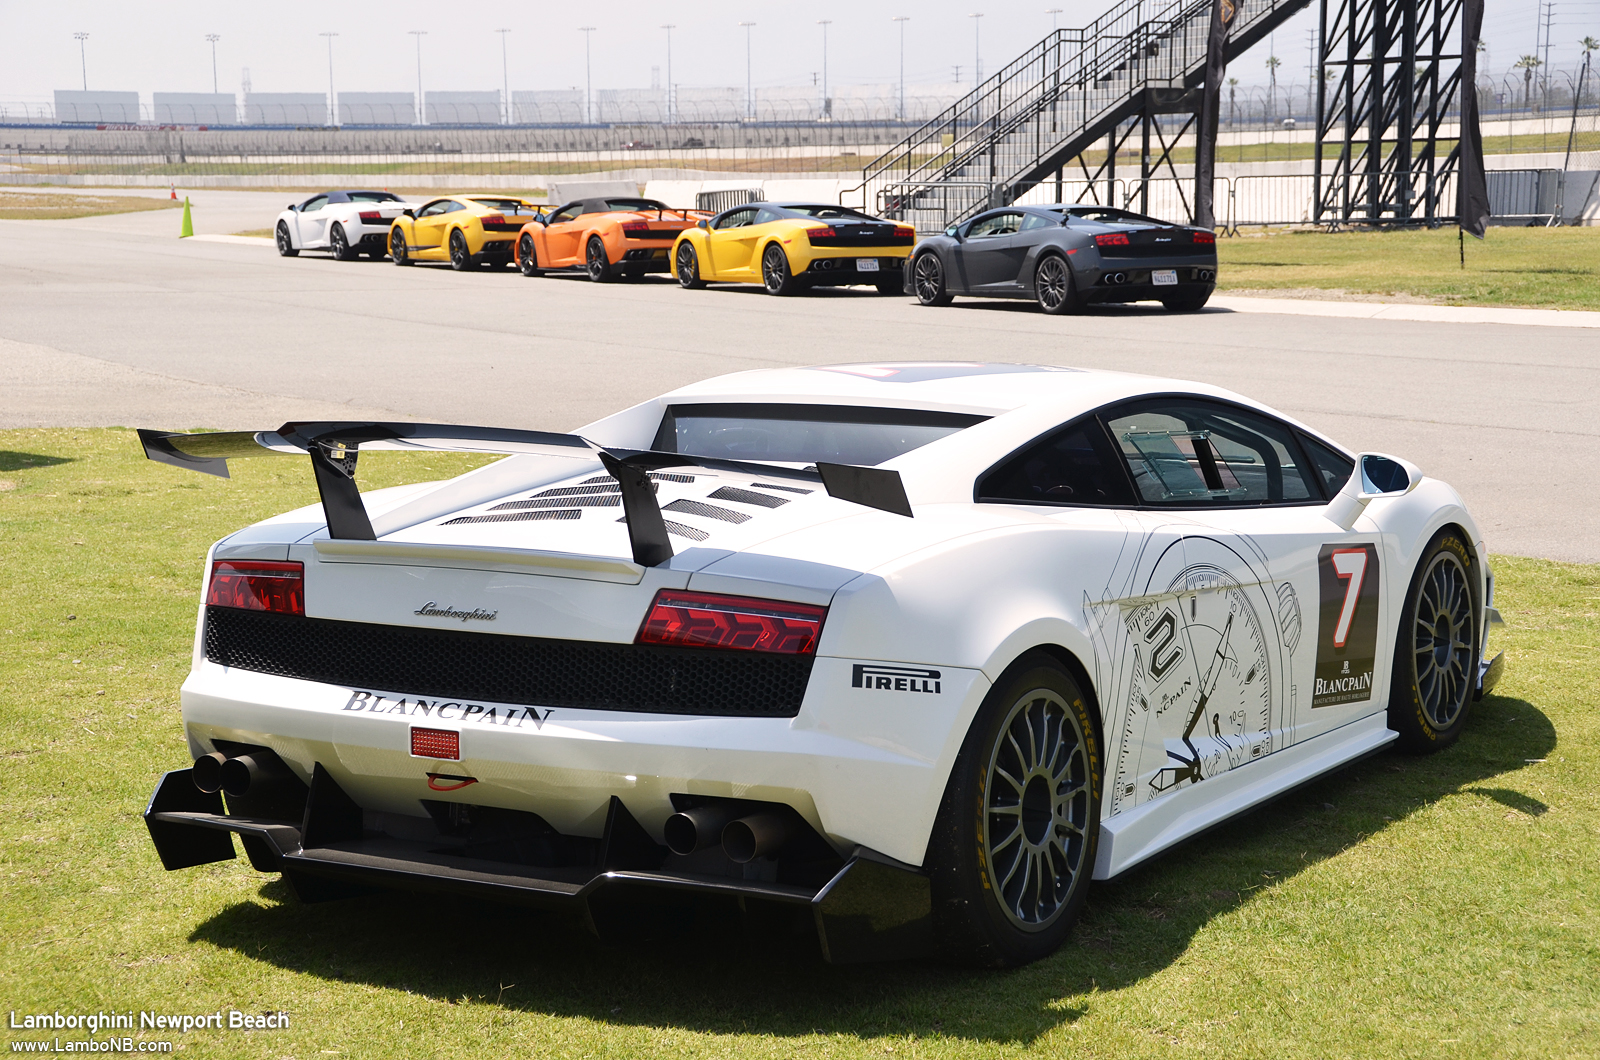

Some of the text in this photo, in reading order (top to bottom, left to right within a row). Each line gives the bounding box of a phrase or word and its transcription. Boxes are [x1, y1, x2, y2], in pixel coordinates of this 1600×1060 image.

[413, 600, 499, 622] Lamborghini
[1331, 548, 1368, 648] 7
[851, 663, 941, 694] PIRELLI
[1073, 698, 1099, 800] PIRELLI
